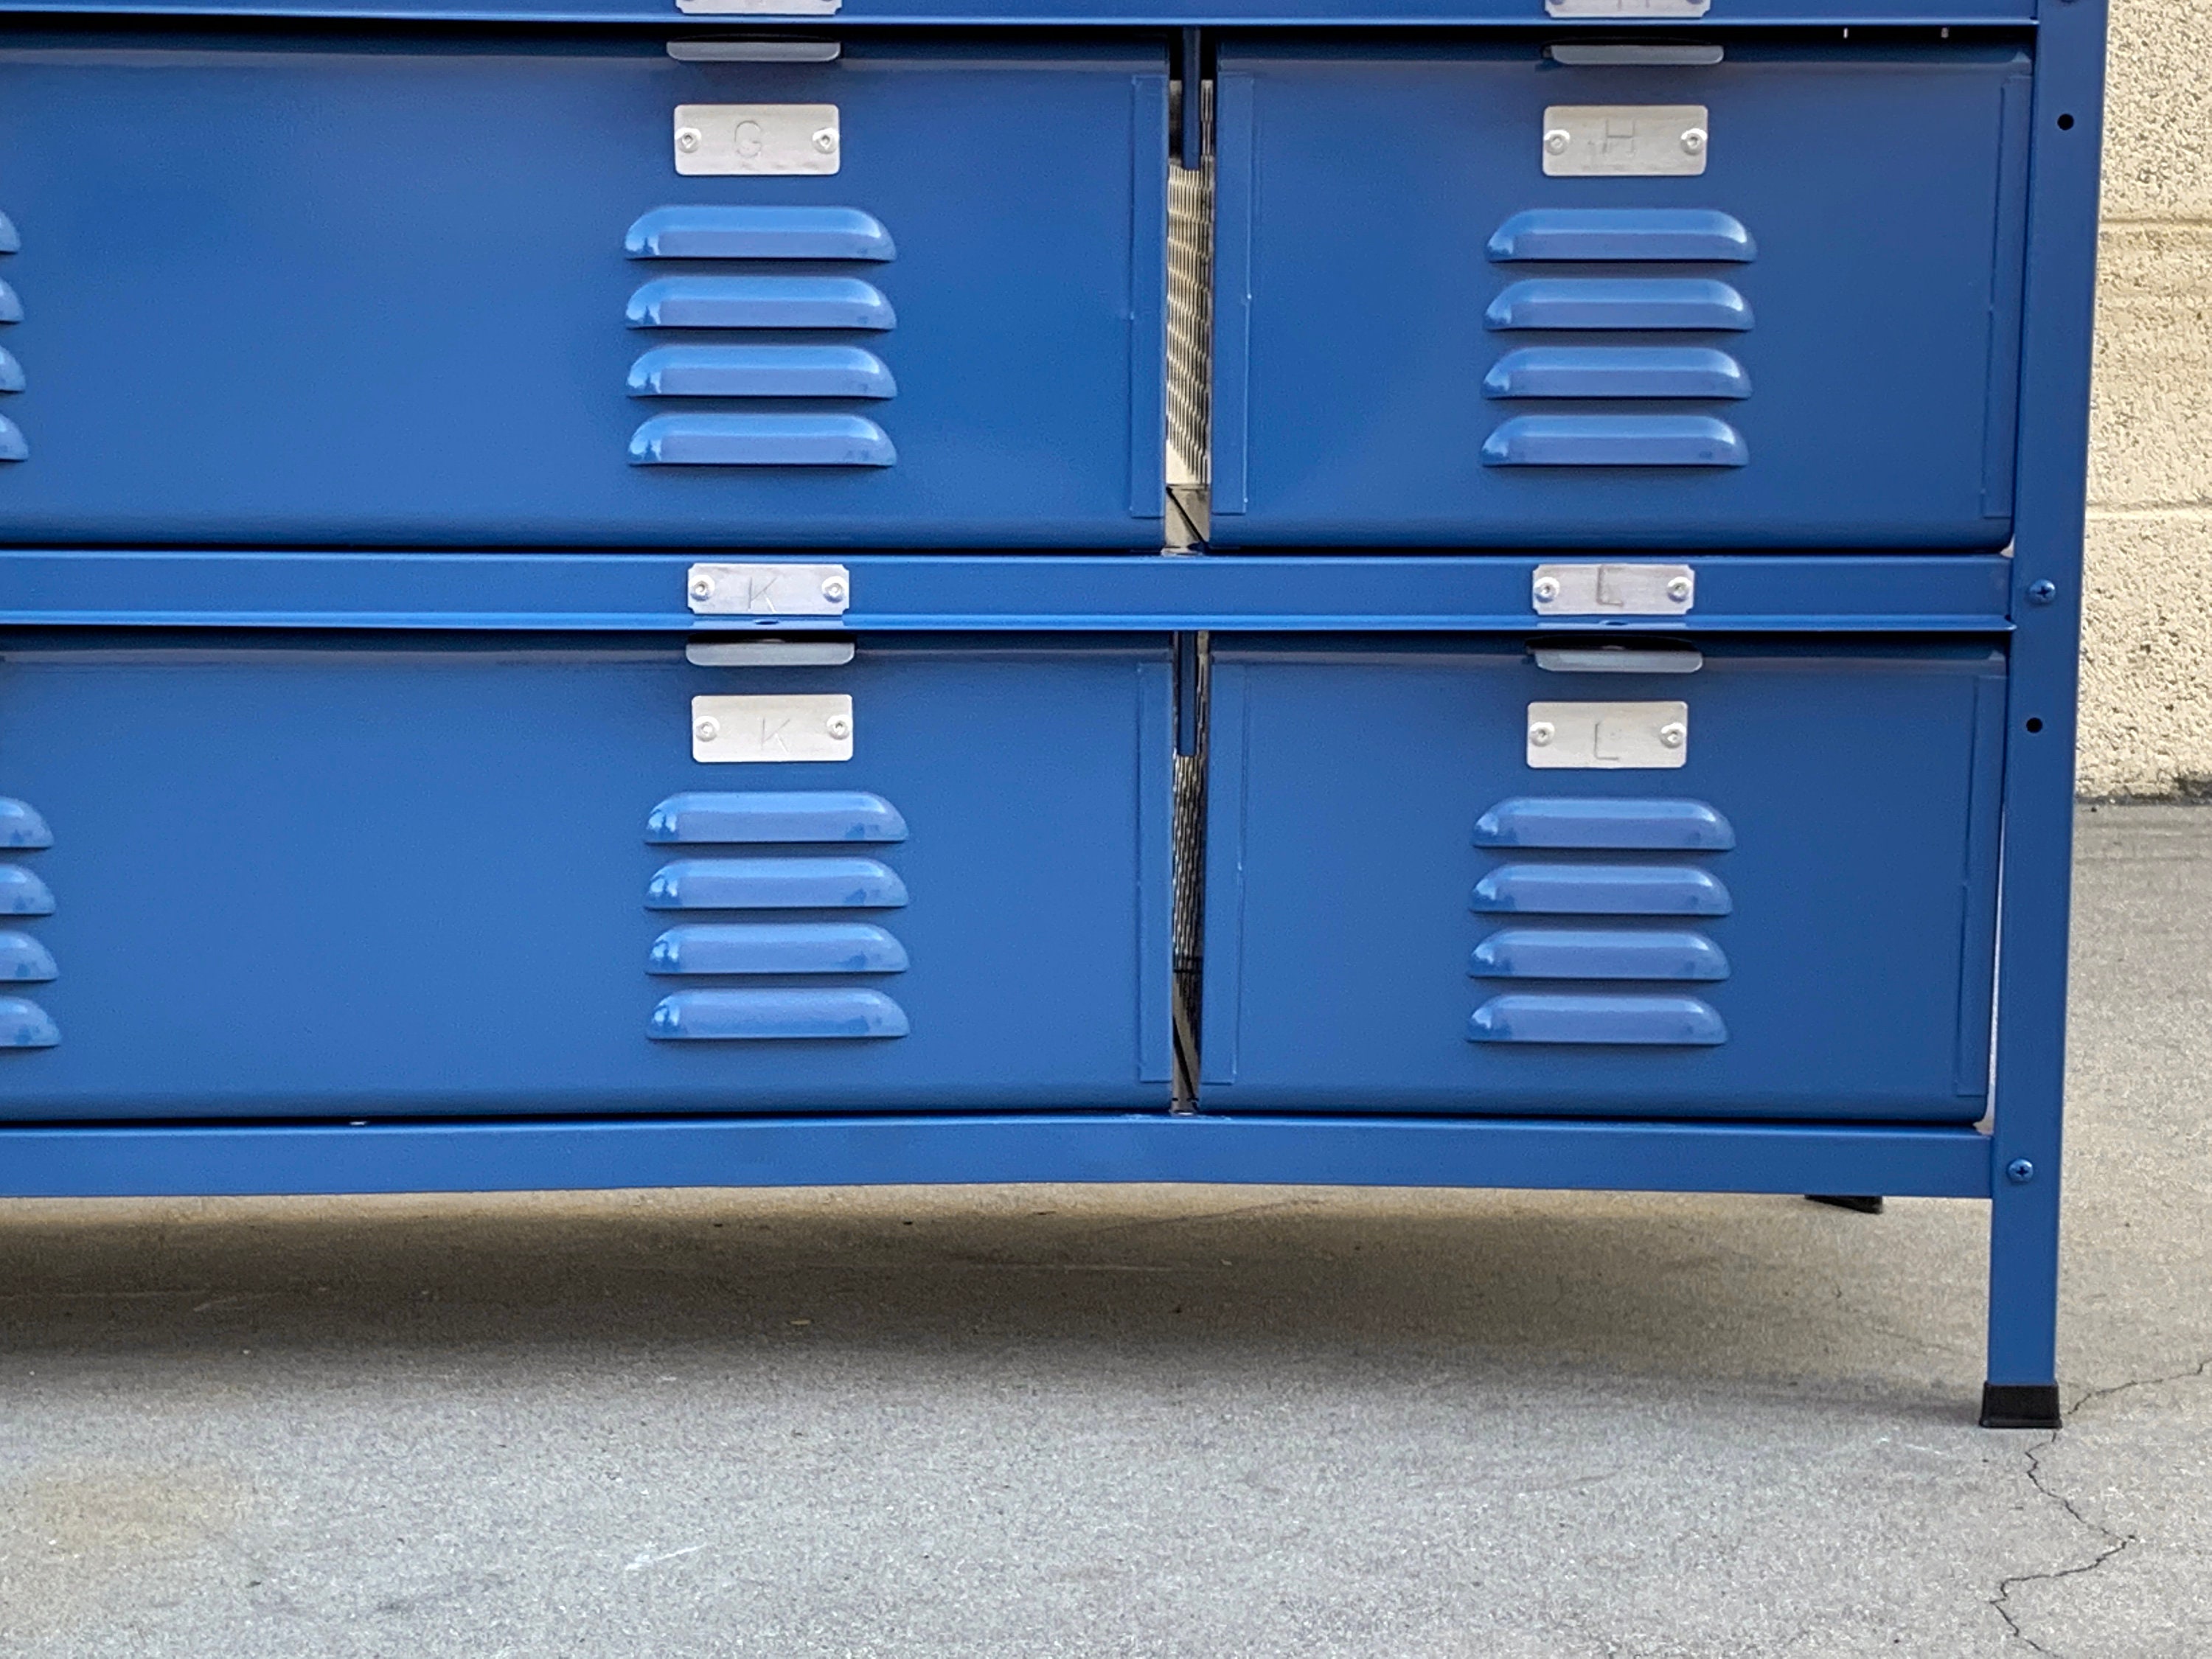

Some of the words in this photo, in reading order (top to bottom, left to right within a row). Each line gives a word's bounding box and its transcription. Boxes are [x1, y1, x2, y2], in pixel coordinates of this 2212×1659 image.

[734, 120, 762, 159] G
[1602, 119, 1635, 155] H
[748, 577, 778, 613] K
[1596, 566, 1624, 607] L
[760, 717, 791, 754] K
[1594, 721, 1620, 760] L
